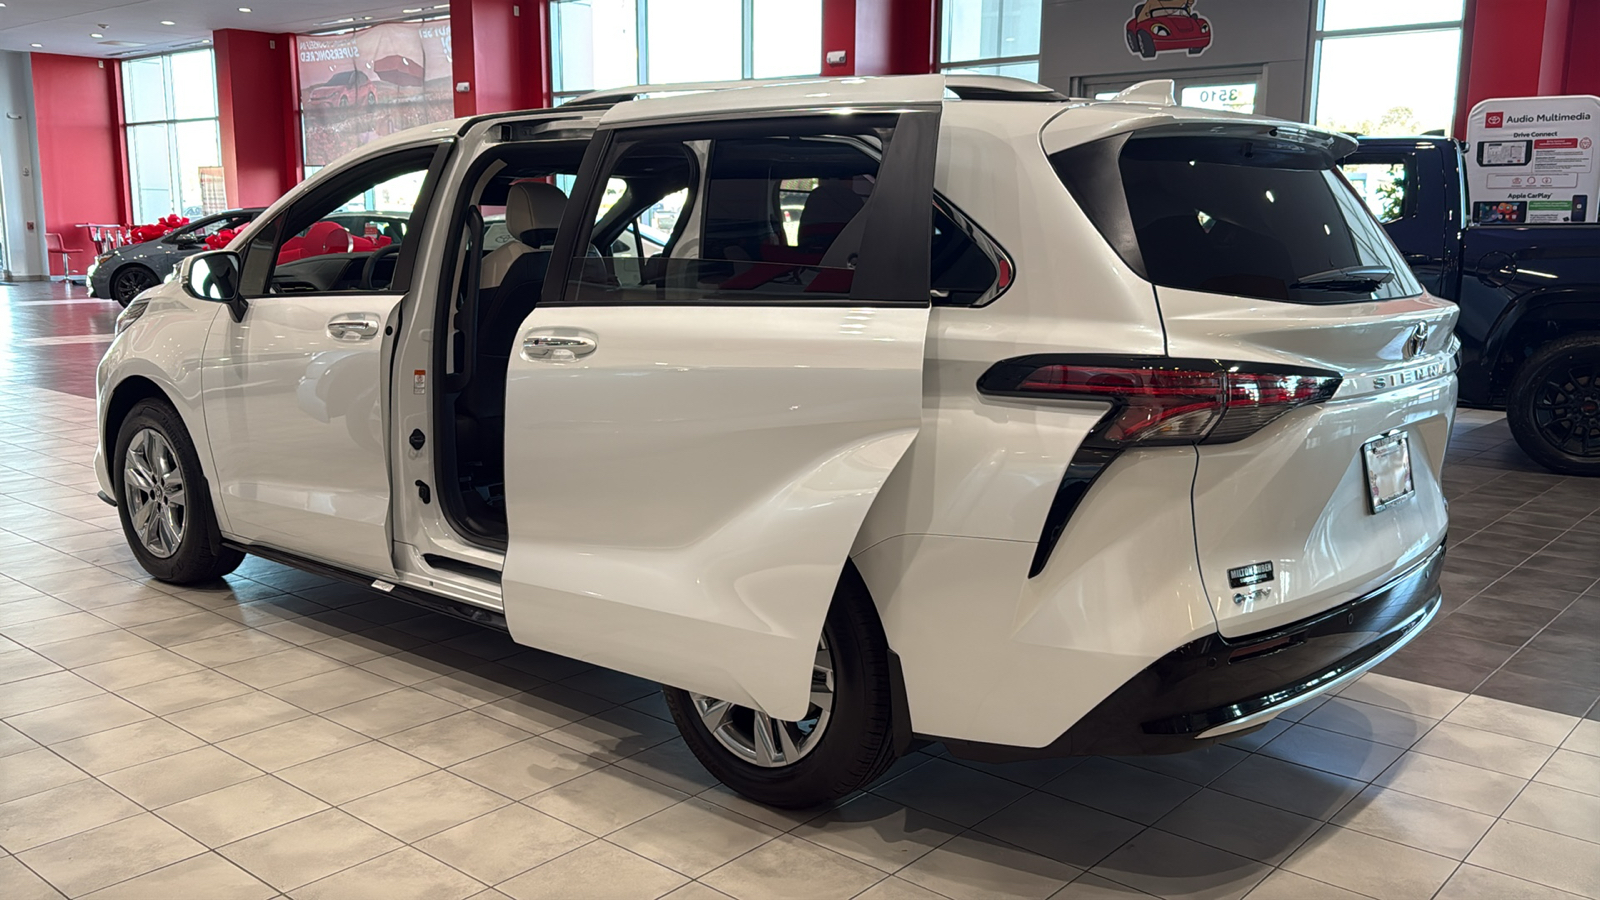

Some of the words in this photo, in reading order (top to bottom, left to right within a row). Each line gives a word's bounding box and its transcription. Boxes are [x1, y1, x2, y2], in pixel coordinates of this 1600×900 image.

[1507, 115, 1534, 124] Audio
[1536, 112, 1591, 122] Multimedia
[1373, 364, 1447, 389] SIENNA
[1231, 567, 1252, 579] MILTON
